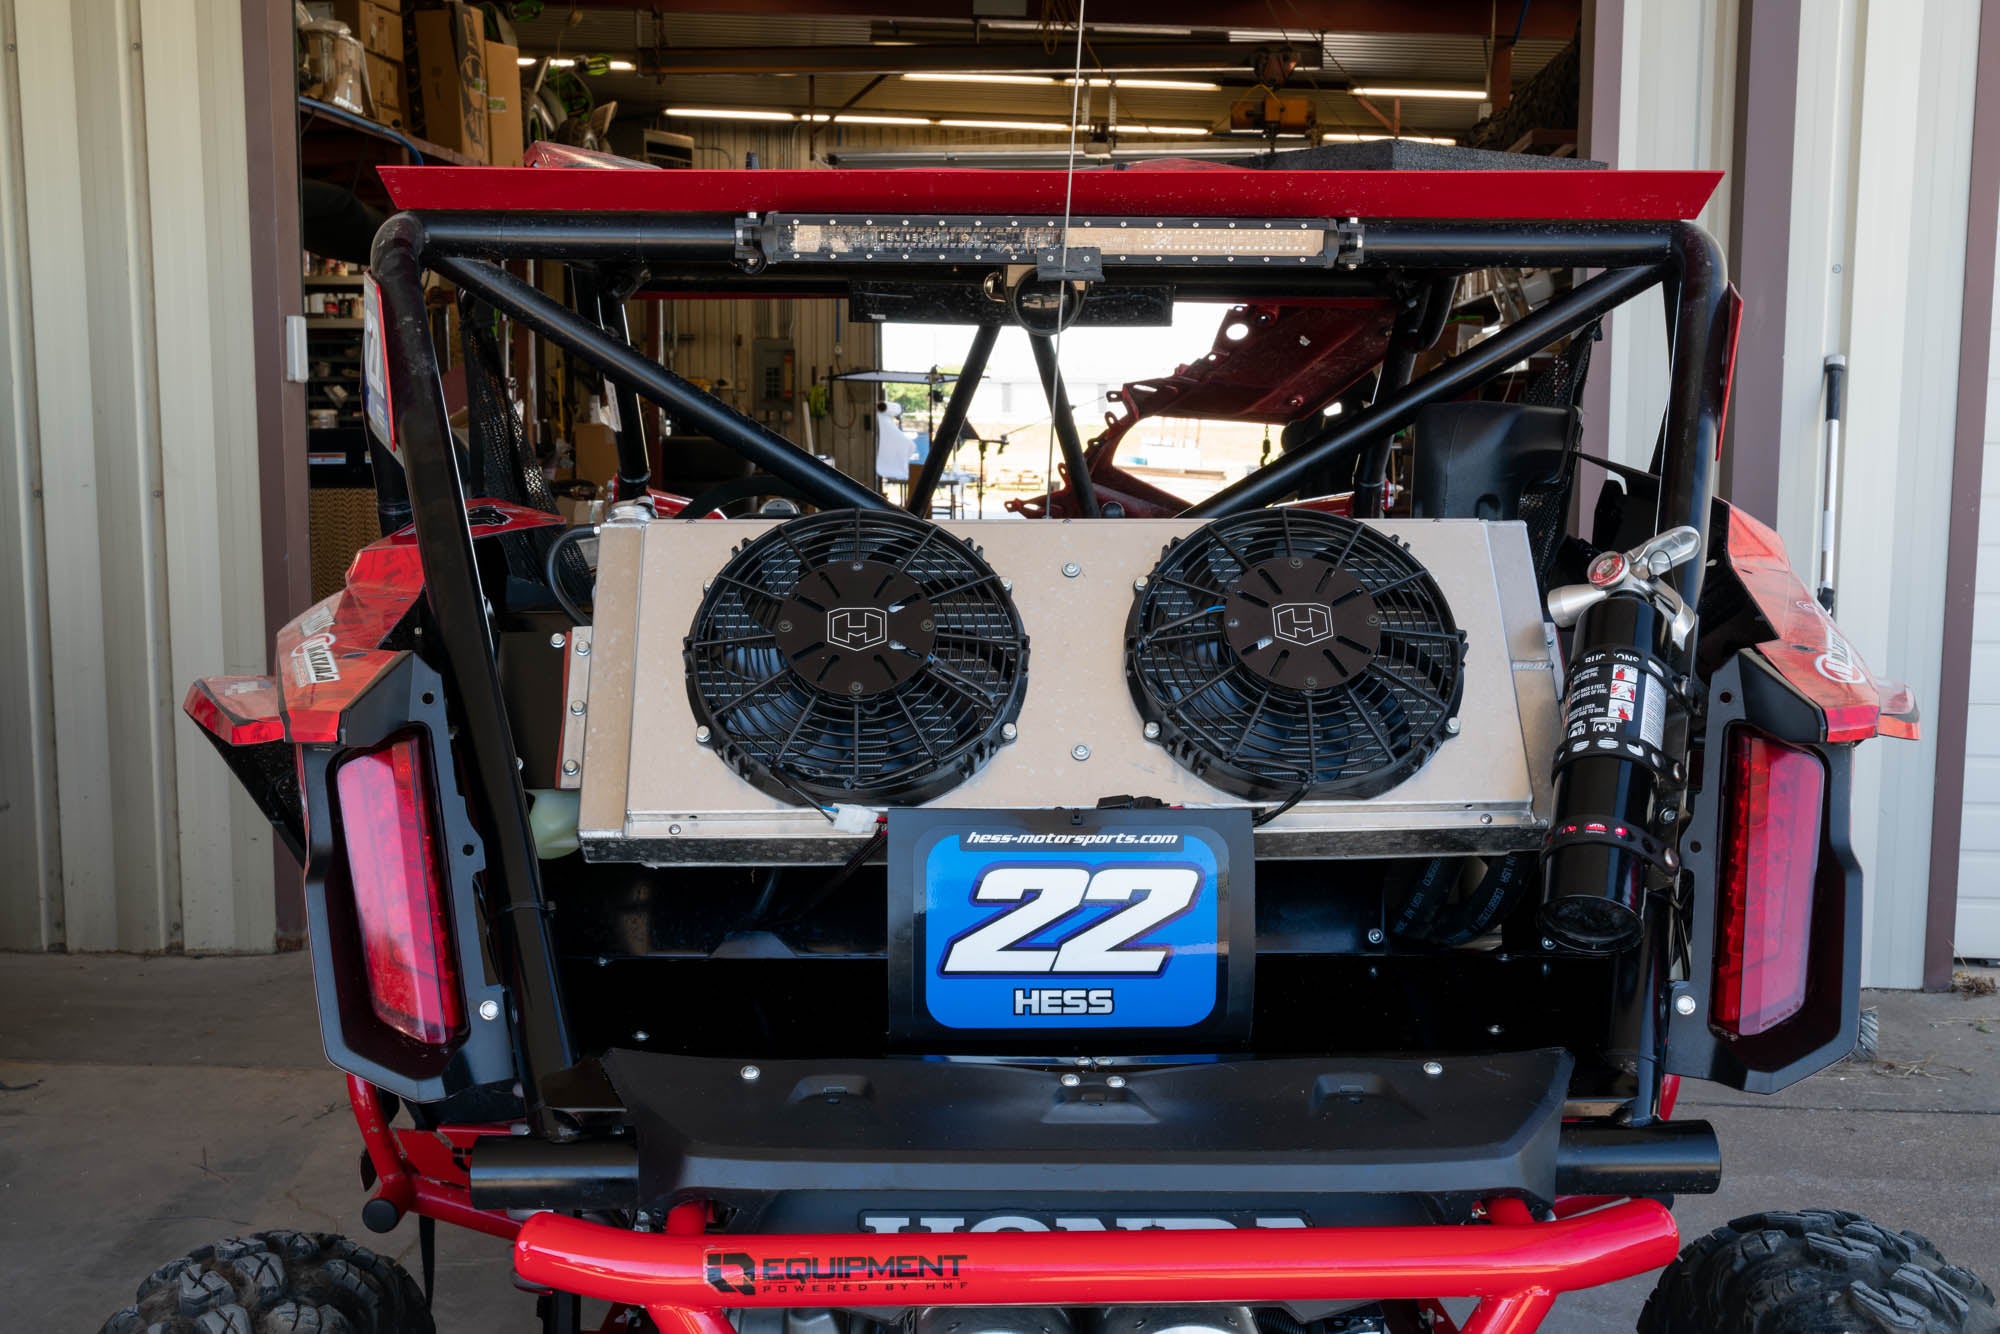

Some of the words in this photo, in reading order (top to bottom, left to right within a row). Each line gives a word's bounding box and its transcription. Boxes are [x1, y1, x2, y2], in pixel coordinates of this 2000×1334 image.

[965, 831, 1179, 847] hess-motorsports.com
[941, 865, 1202, 974] 22
[1013, 988, 1114, 1016] HESS
[762, 1254, 969, 1284] EQUIPMENT
[763, 1284, 868, 1293] POWERED
[884, 1283, 909, 1292] BY
[925, 1281, 970, 1291] HMF
